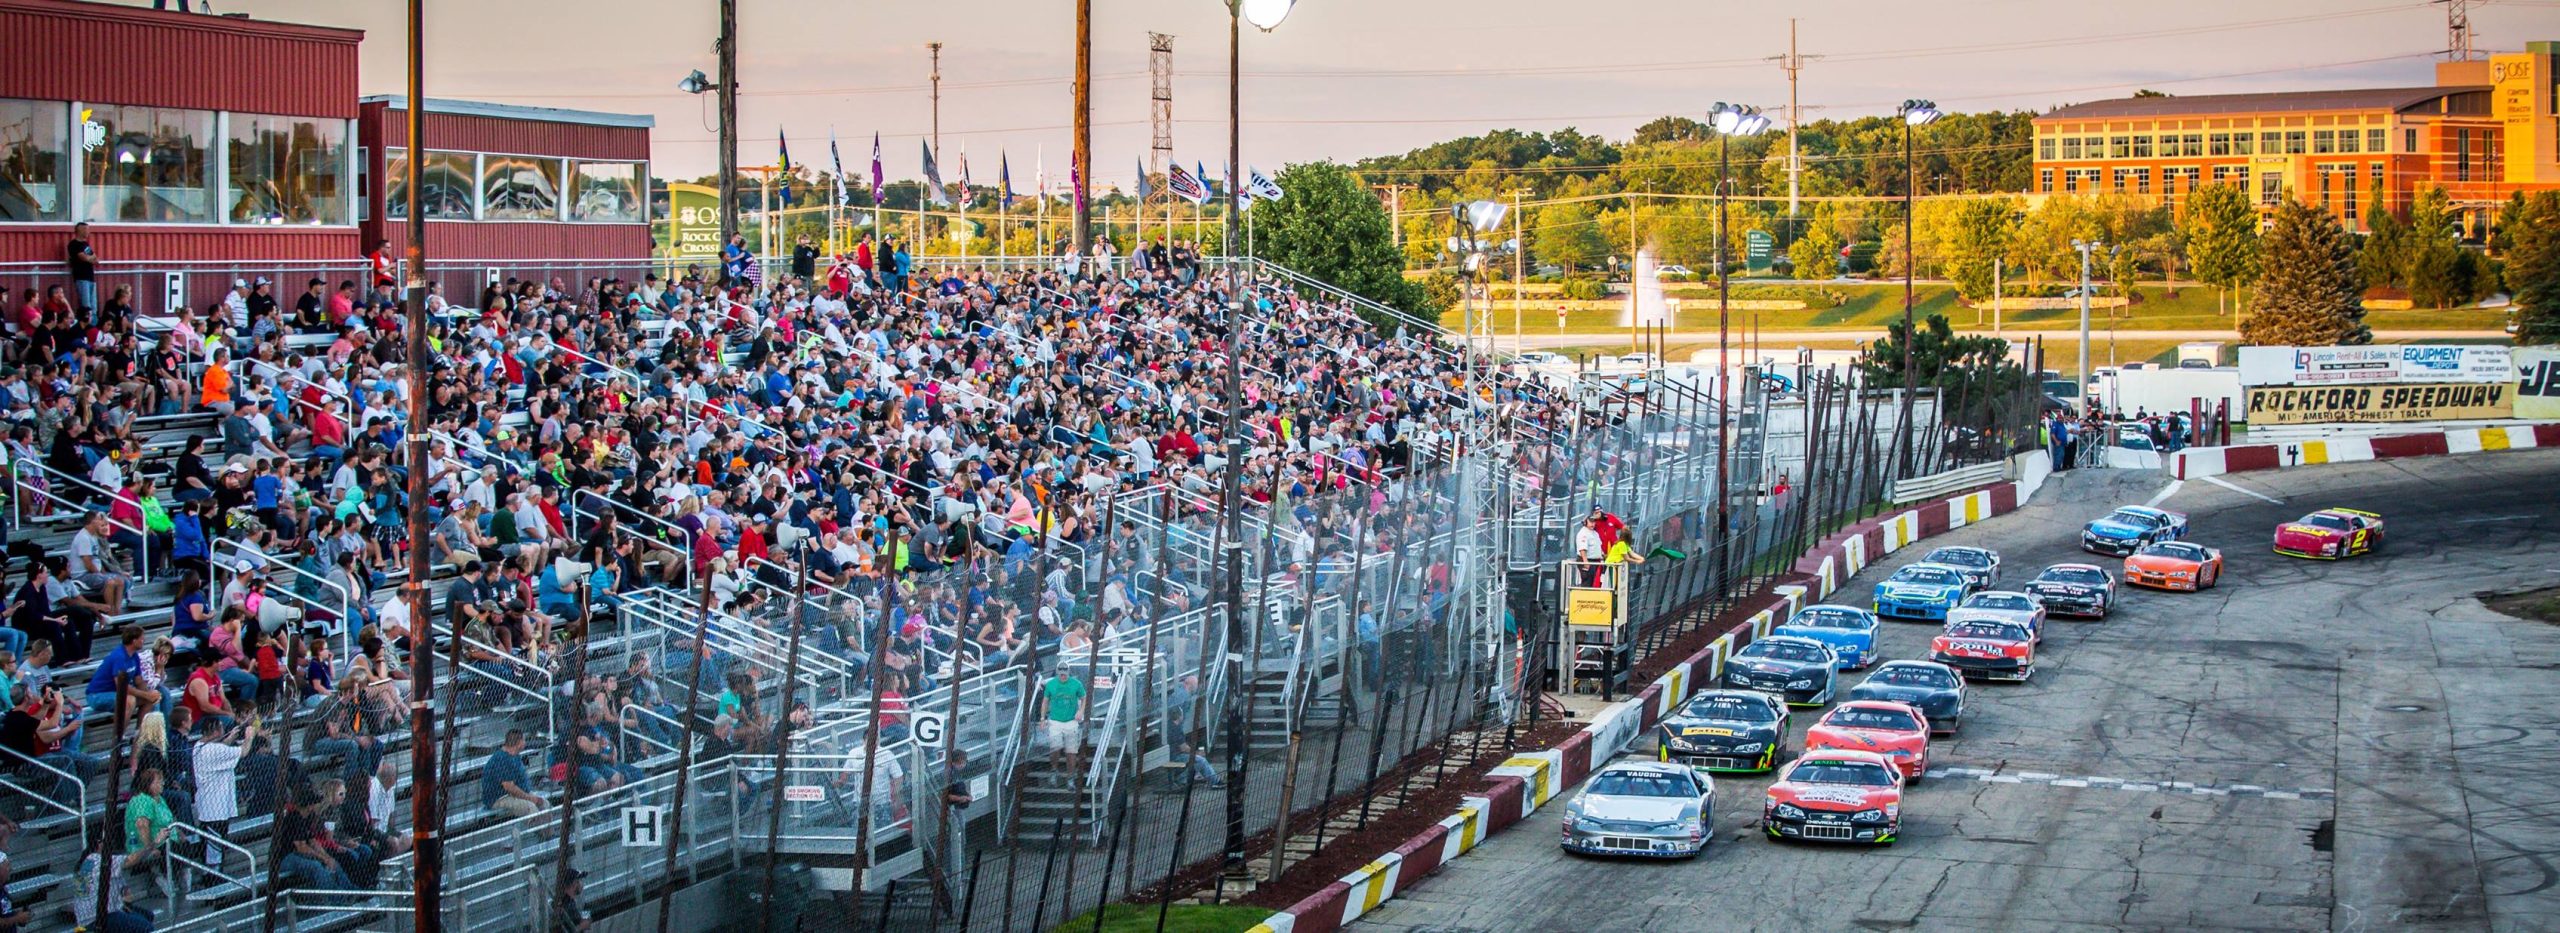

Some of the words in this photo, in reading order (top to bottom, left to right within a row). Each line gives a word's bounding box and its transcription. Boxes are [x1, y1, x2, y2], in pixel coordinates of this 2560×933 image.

[2507, 62, 2530, 76] OSF
[697, 207, 721, 225] OS
[681, 232, 711, 242] ROCK
[681, 244, 720, 253] CROSSI
[169, 275, 179, 310] F
[2314, 353, 2335, 361] Lincoln
[2363, 351, 2368, 360] &
[2403, 348, 2464, 362] EQUIPMENT
[2432, 361, 2454, 369] DEPOT
[2250, 388, 2371, 413] ROCKFORD
[2381, 386, 2502, 409] SPEEDWAY
[2400, 410, 2432, 419] TRACK
[2287, 445, 2298, 466] 4
[2352, 529, 2366, 548] 2
[914, 716, 941, 743] G
[629, 811, 656, 842] H
